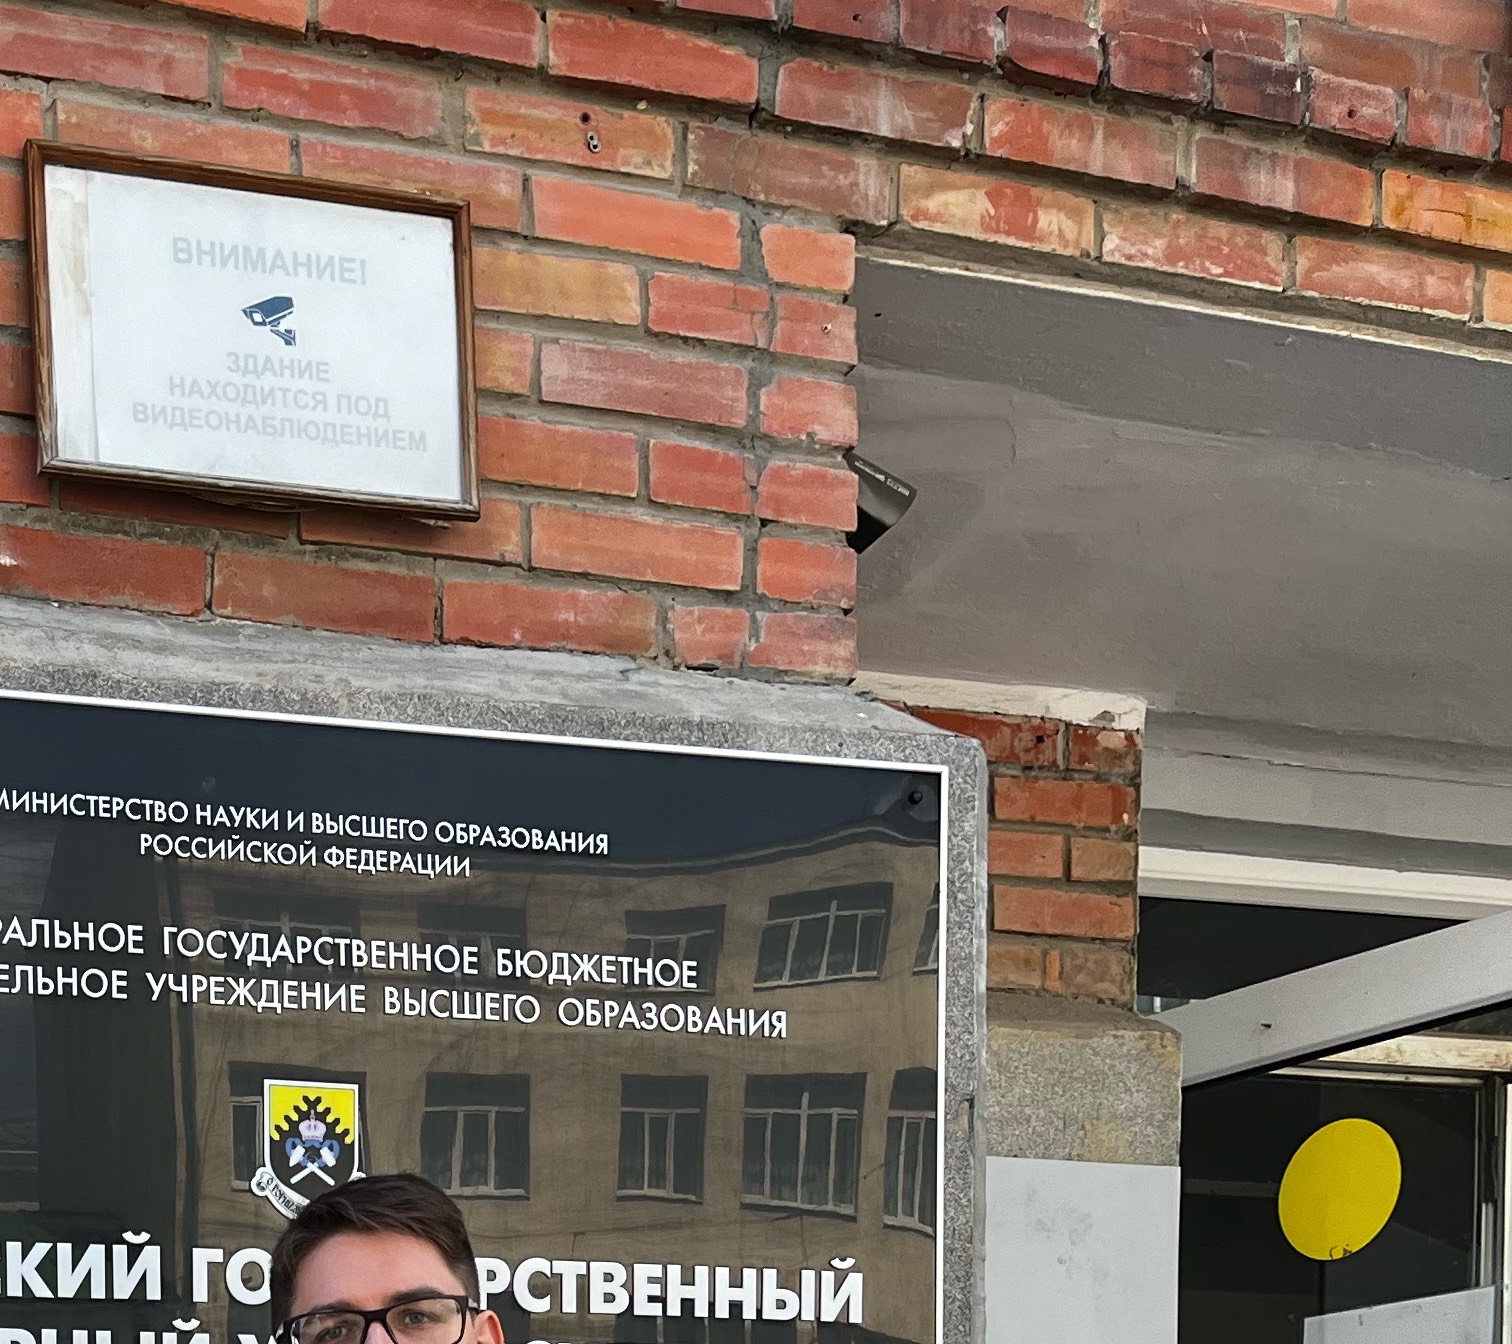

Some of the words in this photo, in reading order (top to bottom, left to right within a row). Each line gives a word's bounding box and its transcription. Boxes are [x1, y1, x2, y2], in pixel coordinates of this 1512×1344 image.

[171, 236, 368, 286] ВНИМАНИЕ!
[226, 351, 330, 384] ЗДАНИЕ
[168, 375, 328, 414] НАХОДИТСЯ
[334, 393, 391, 423] ПОД
[131, 401, 428, 453] ВИДЕОНАБЛЮДЕНИЕМ
[195, 803, 279, 831] НАУКИ
[287, 810, 304, 833] И
[311, 812, 428, 841] ВЫСШЕГО
[434, 821, 609, 856] ОБРАЗОВАНИЯ
[140, 833, 318, 867] РОССИЙСКОЙ
[323, 845, 471, 879] ФЕДЕРАЦИИ
[163, 926, 480, 975] ГОСУДАРСТВЕННОЕ
[496, 948, 699, 989] БЮДЖЕТНОЕ
[145, 972, 367, 1014] УЧРЕЖДЕНИЕ
[384, 986, 542, 1025] ВЫСШЕГО
[558, 997, 788, 1039] ОБРАЗОВАНИЯ
[192, 1246, 865, 1325] ГОРСТВЕННЫЙ
